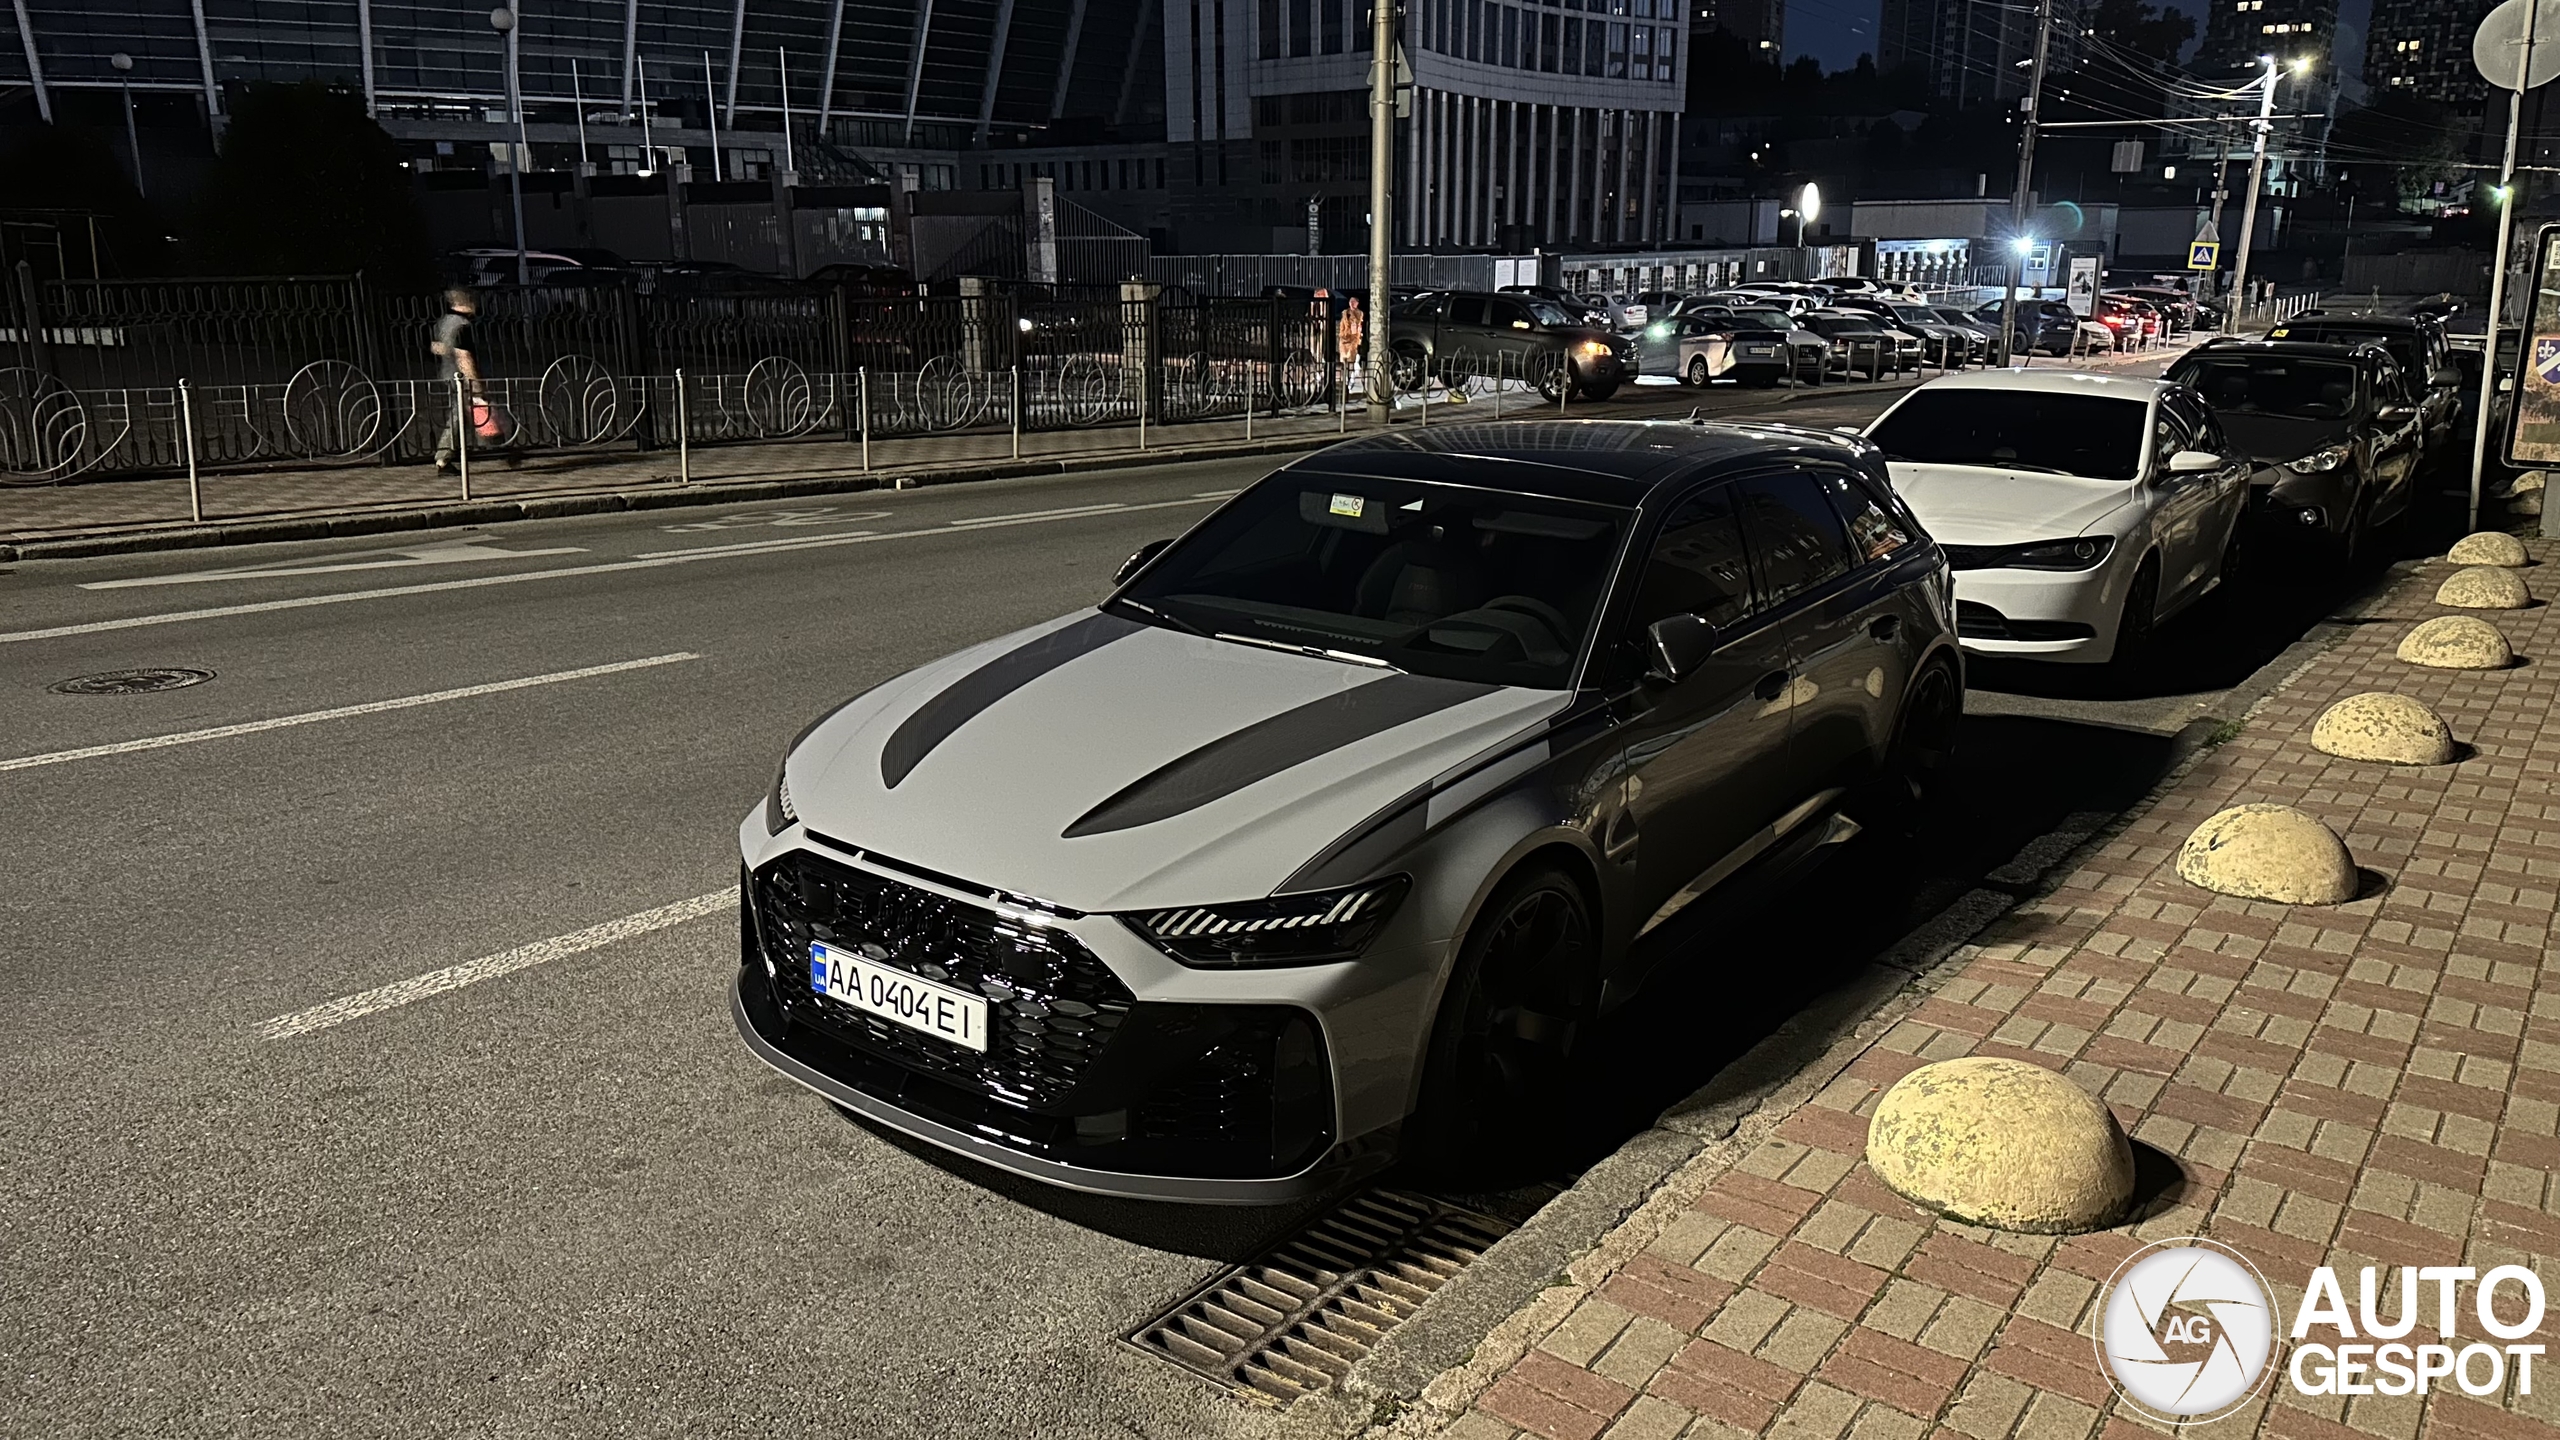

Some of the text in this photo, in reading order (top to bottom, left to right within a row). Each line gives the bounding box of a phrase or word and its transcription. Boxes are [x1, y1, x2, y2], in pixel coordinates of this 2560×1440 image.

[815, 974, 825, 987] UA
[830, 960, 969, 1038] AA 0404 EI
